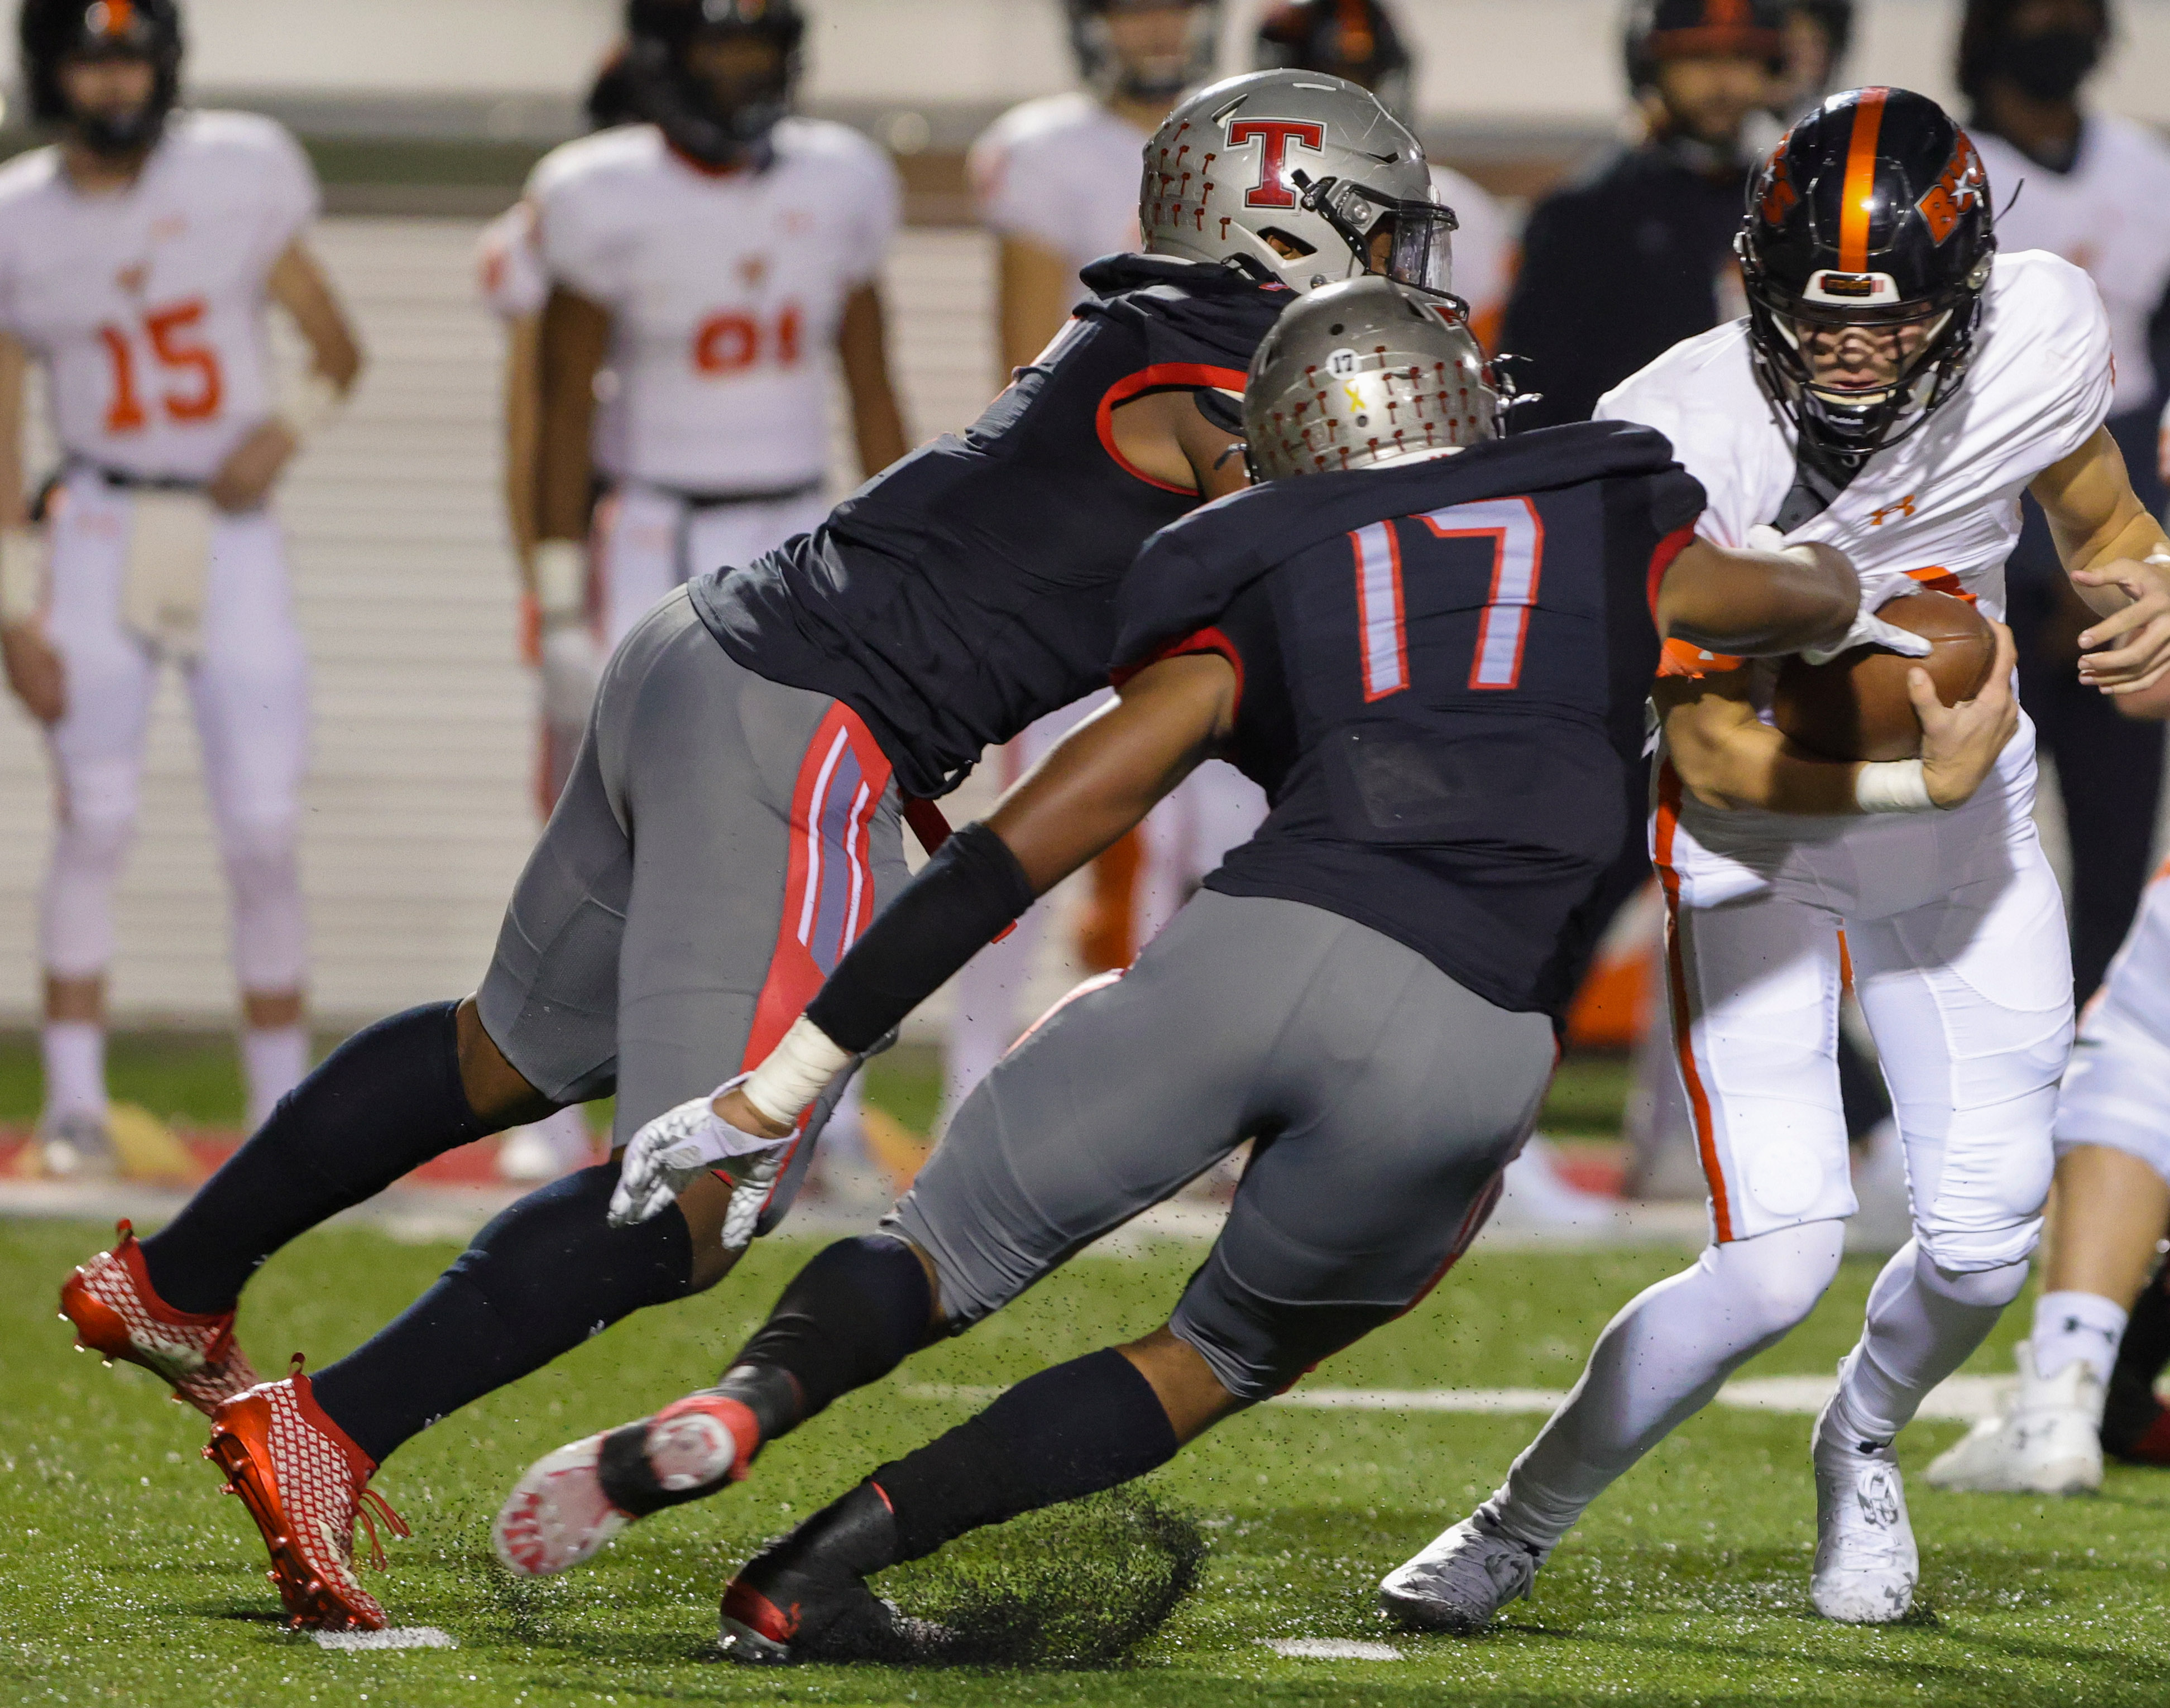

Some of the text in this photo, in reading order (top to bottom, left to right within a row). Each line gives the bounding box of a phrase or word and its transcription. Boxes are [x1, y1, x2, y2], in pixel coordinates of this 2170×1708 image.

[1225, 118, 1327, 213] T
[99, 295, 224, 434] 15
[1334, 353, 1352, 373] 17
[1347, 496, 1545, 703] 17
